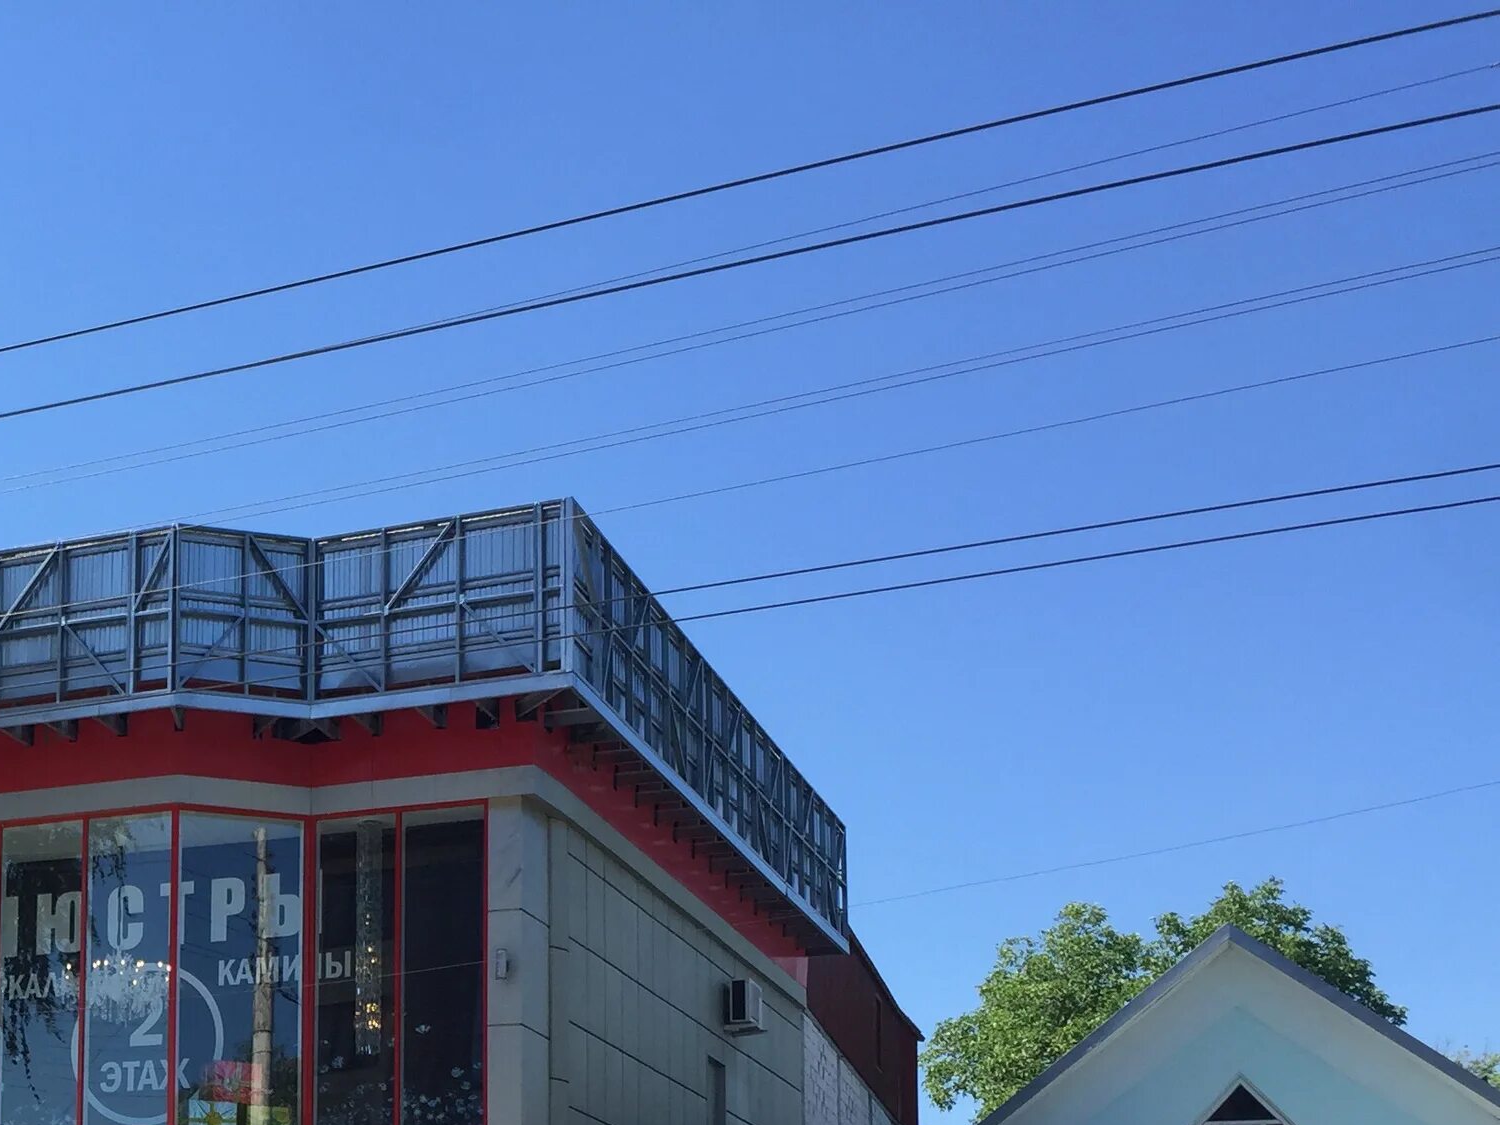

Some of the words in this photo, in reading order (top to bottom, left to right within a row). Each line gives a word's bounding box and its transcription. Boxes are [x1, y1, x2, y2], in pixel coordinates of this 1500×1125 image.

[218, 951, 351, 986] КАМИЫ
[129, 980, 164, 1047] 2
[100, 1058, 191, 1093] ЭТАЖ
